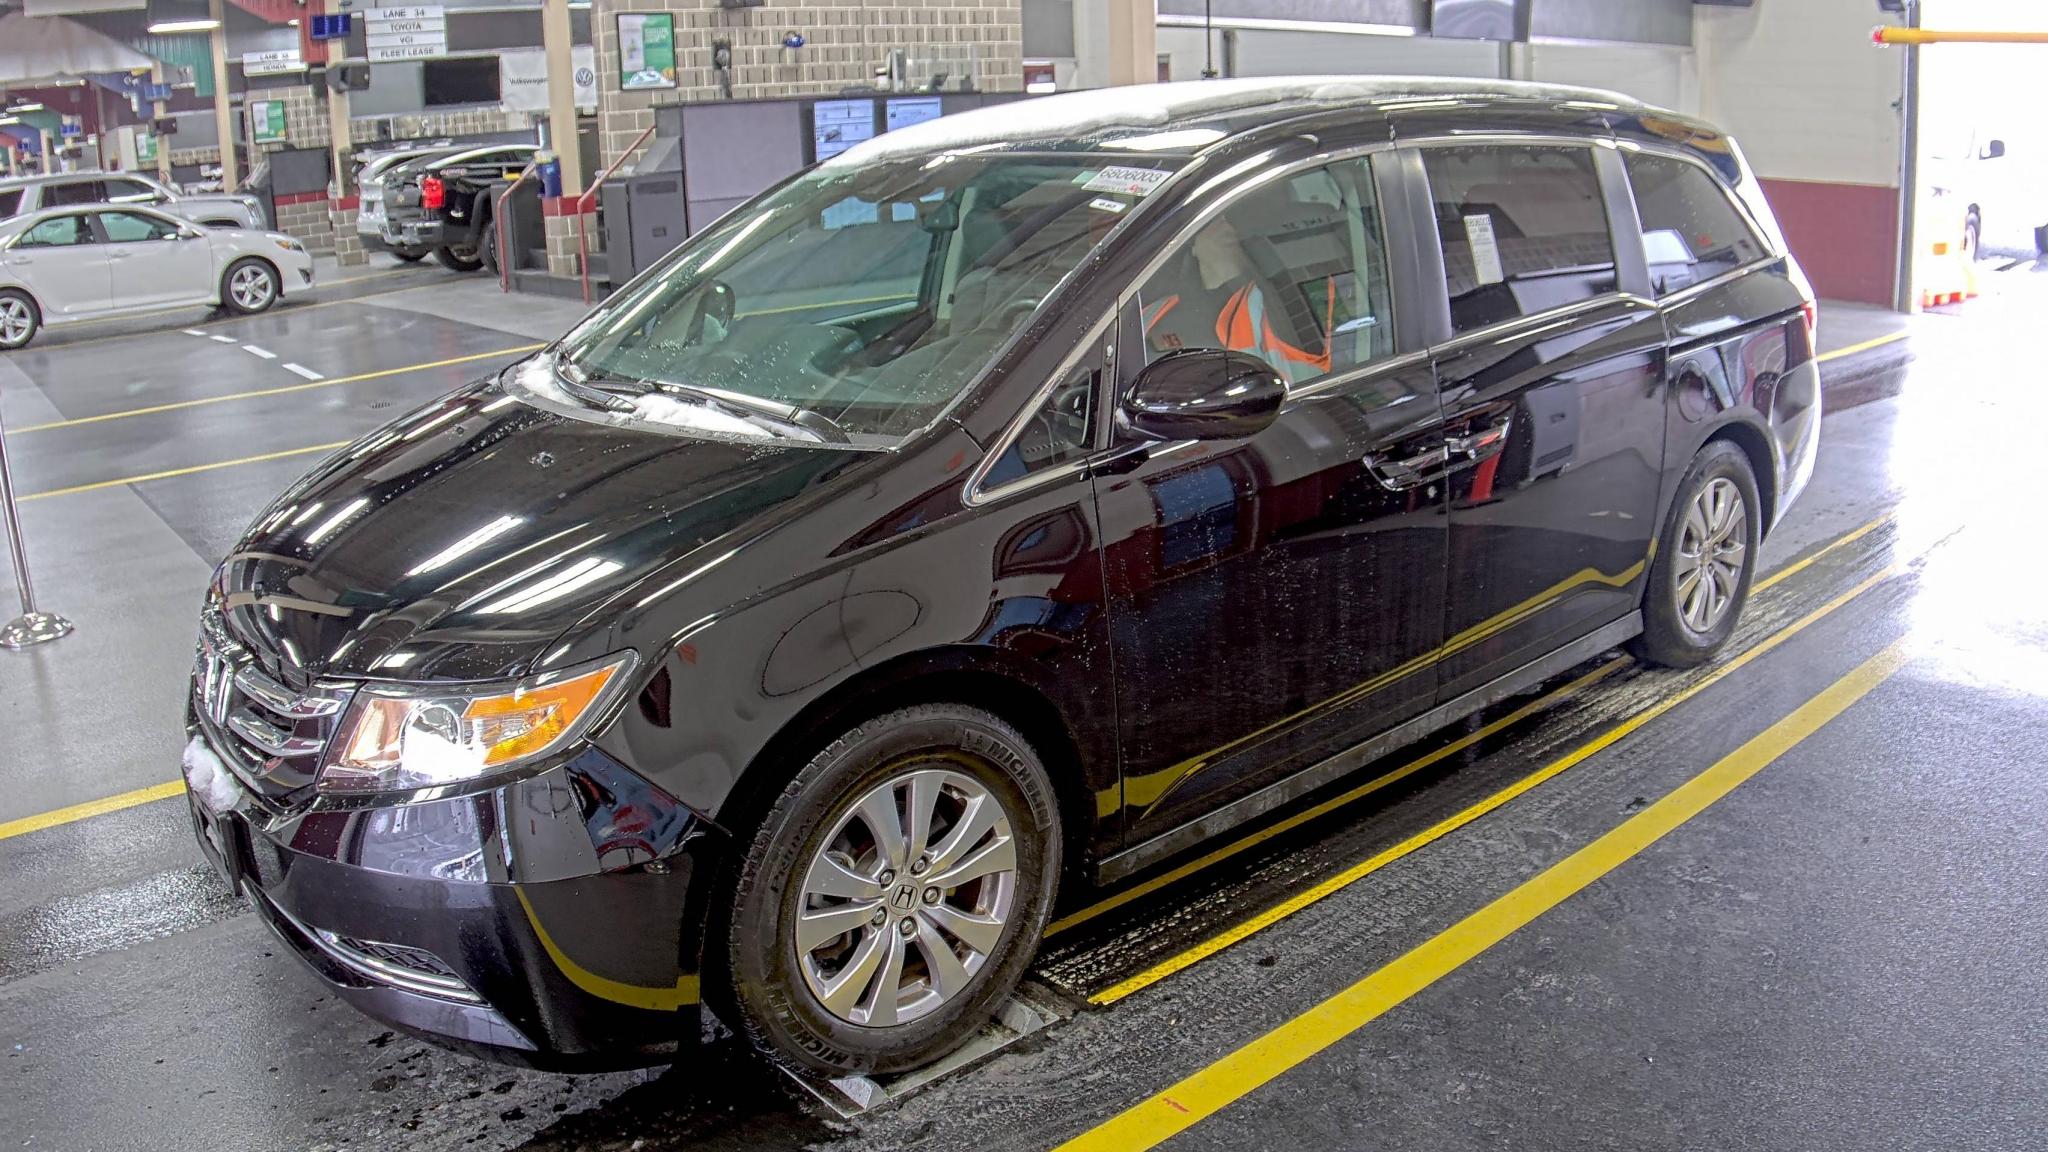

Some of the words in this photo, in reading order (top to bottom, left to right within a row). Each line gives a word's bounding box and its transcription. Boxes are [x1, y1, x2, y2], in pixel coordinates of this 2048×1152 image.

[383, 8, 406, 18] LANE
[391, 22, 421, 31] TOYOTA
[400, 36, 413, 44] VCI
[380, 48, 405, 57] FLEET
[408, 47, 434, 56] LEASE
[986, 741, 1051, 826] MICHELIN
